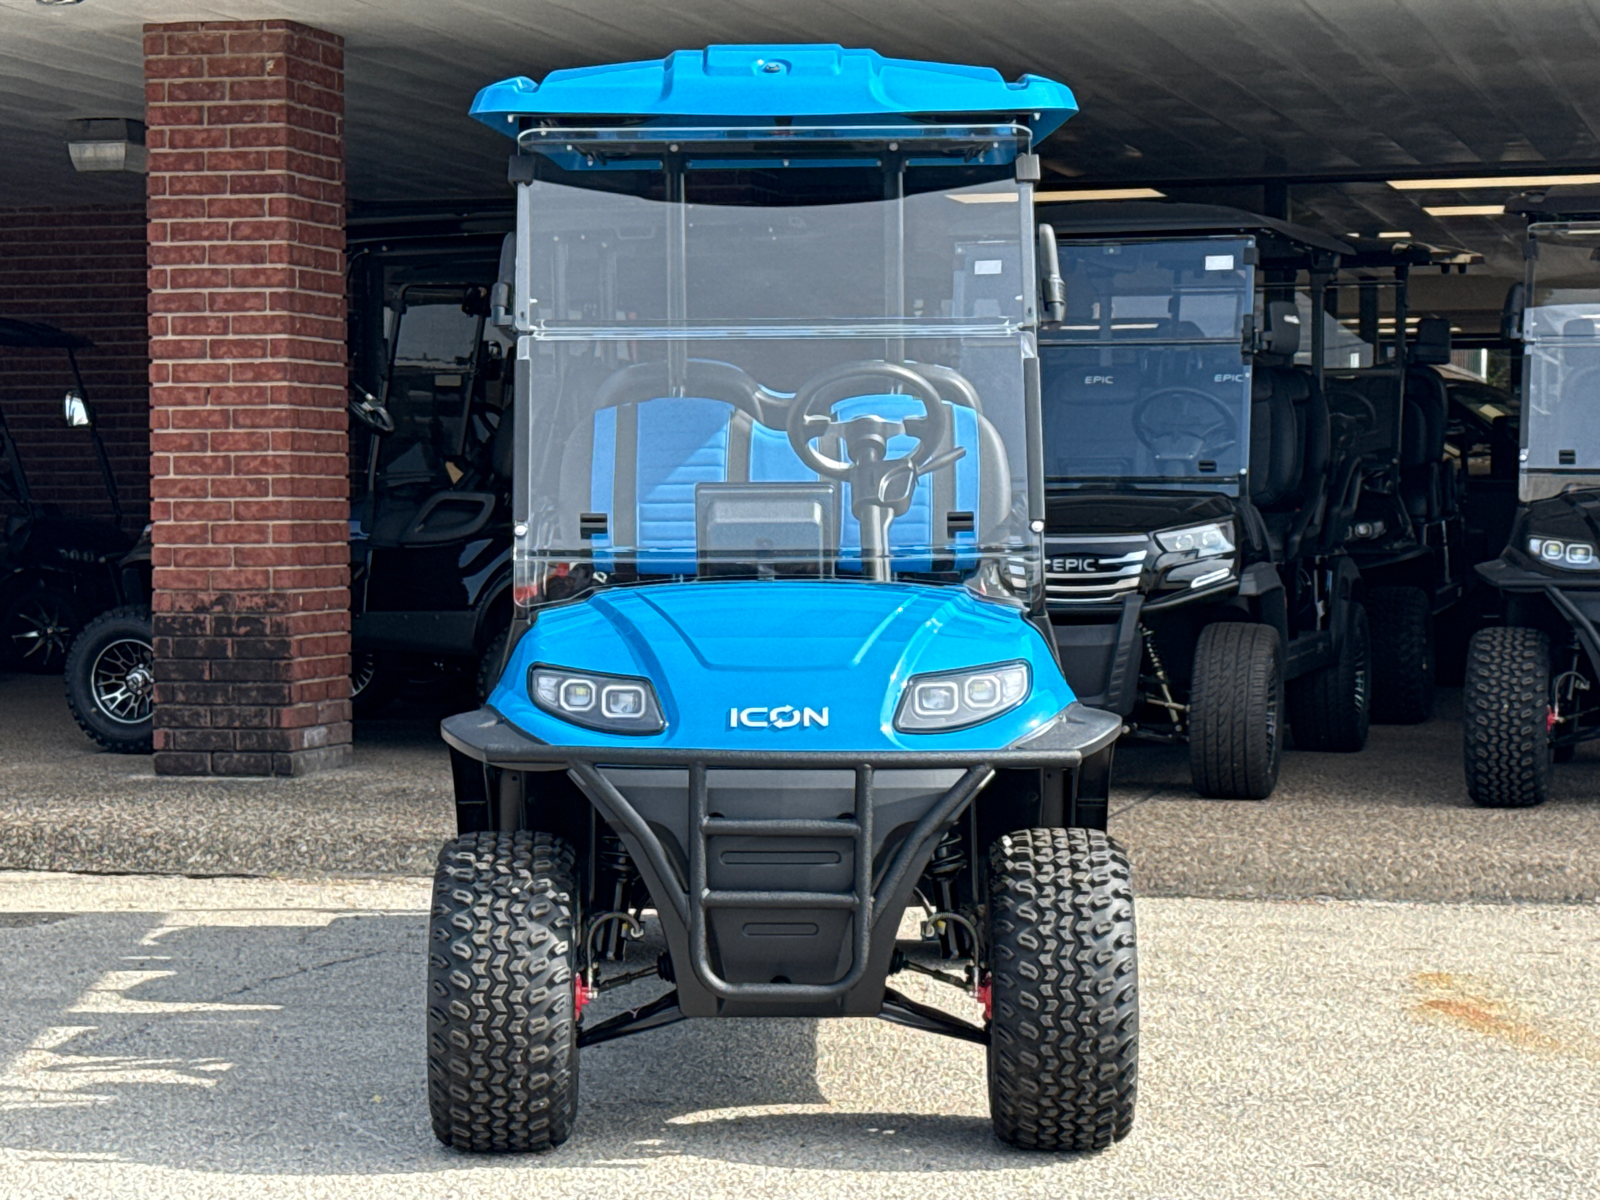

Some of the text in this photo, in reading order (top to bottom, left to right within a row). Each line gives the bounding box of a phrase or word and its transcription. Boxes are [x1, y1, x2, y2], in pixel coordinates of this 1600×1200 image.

[1085, 376, 1113, 385] EPIC
[1214, 374, 1243, 383] EPIC
[1053, 559, 1097, 571] EPIC
[729, 704, 829, 729] ICON
